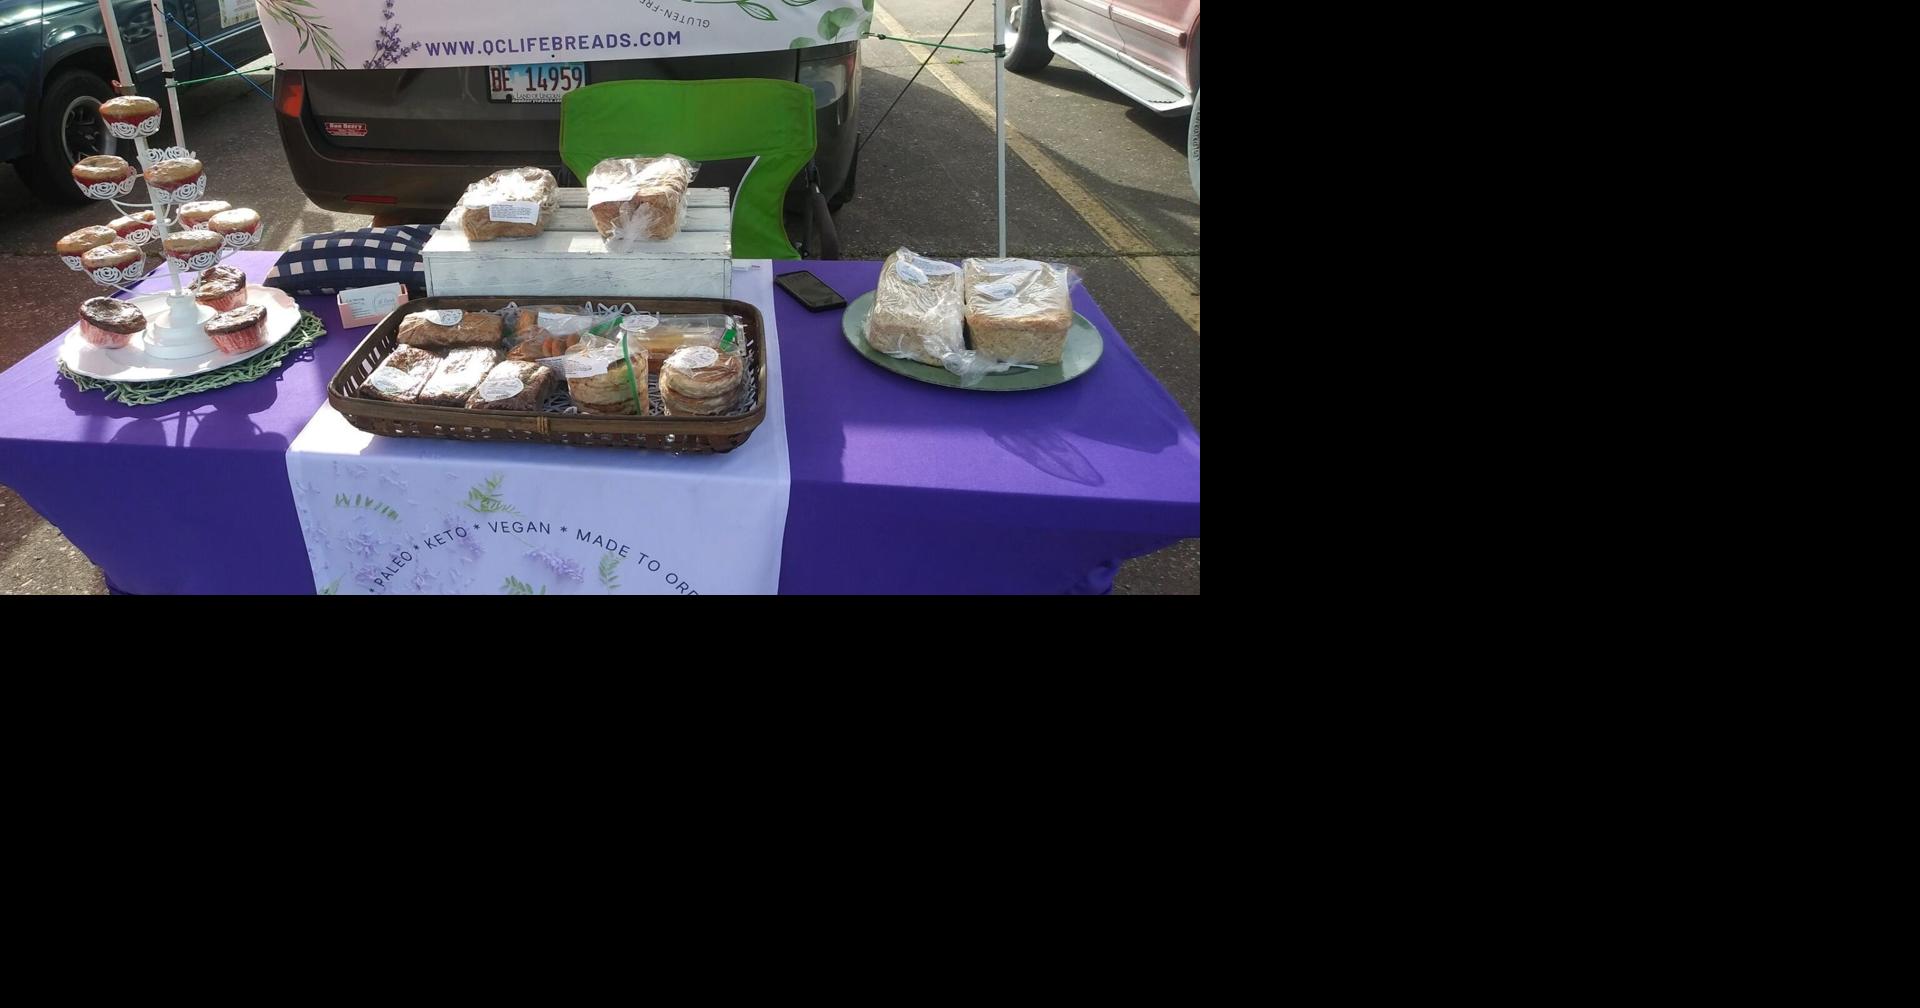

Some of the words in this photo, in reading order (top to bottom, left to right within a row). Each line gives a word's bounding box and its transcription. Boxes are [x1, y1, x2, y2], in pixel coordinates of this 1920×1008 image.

[425, 31, 681, 56] WWW.QCLIFEBREADS.COM
[491, 67, 513, 91] BE
[526, 66, 582, 91] 14959
[374, 551, 413, 587] PALEO
[424, 526, 468, 550] KETO
[488, 521, 551, 535] VEGAN
[576, 529, 631, 558] MADE
[637, 552, 661, 572] TO
